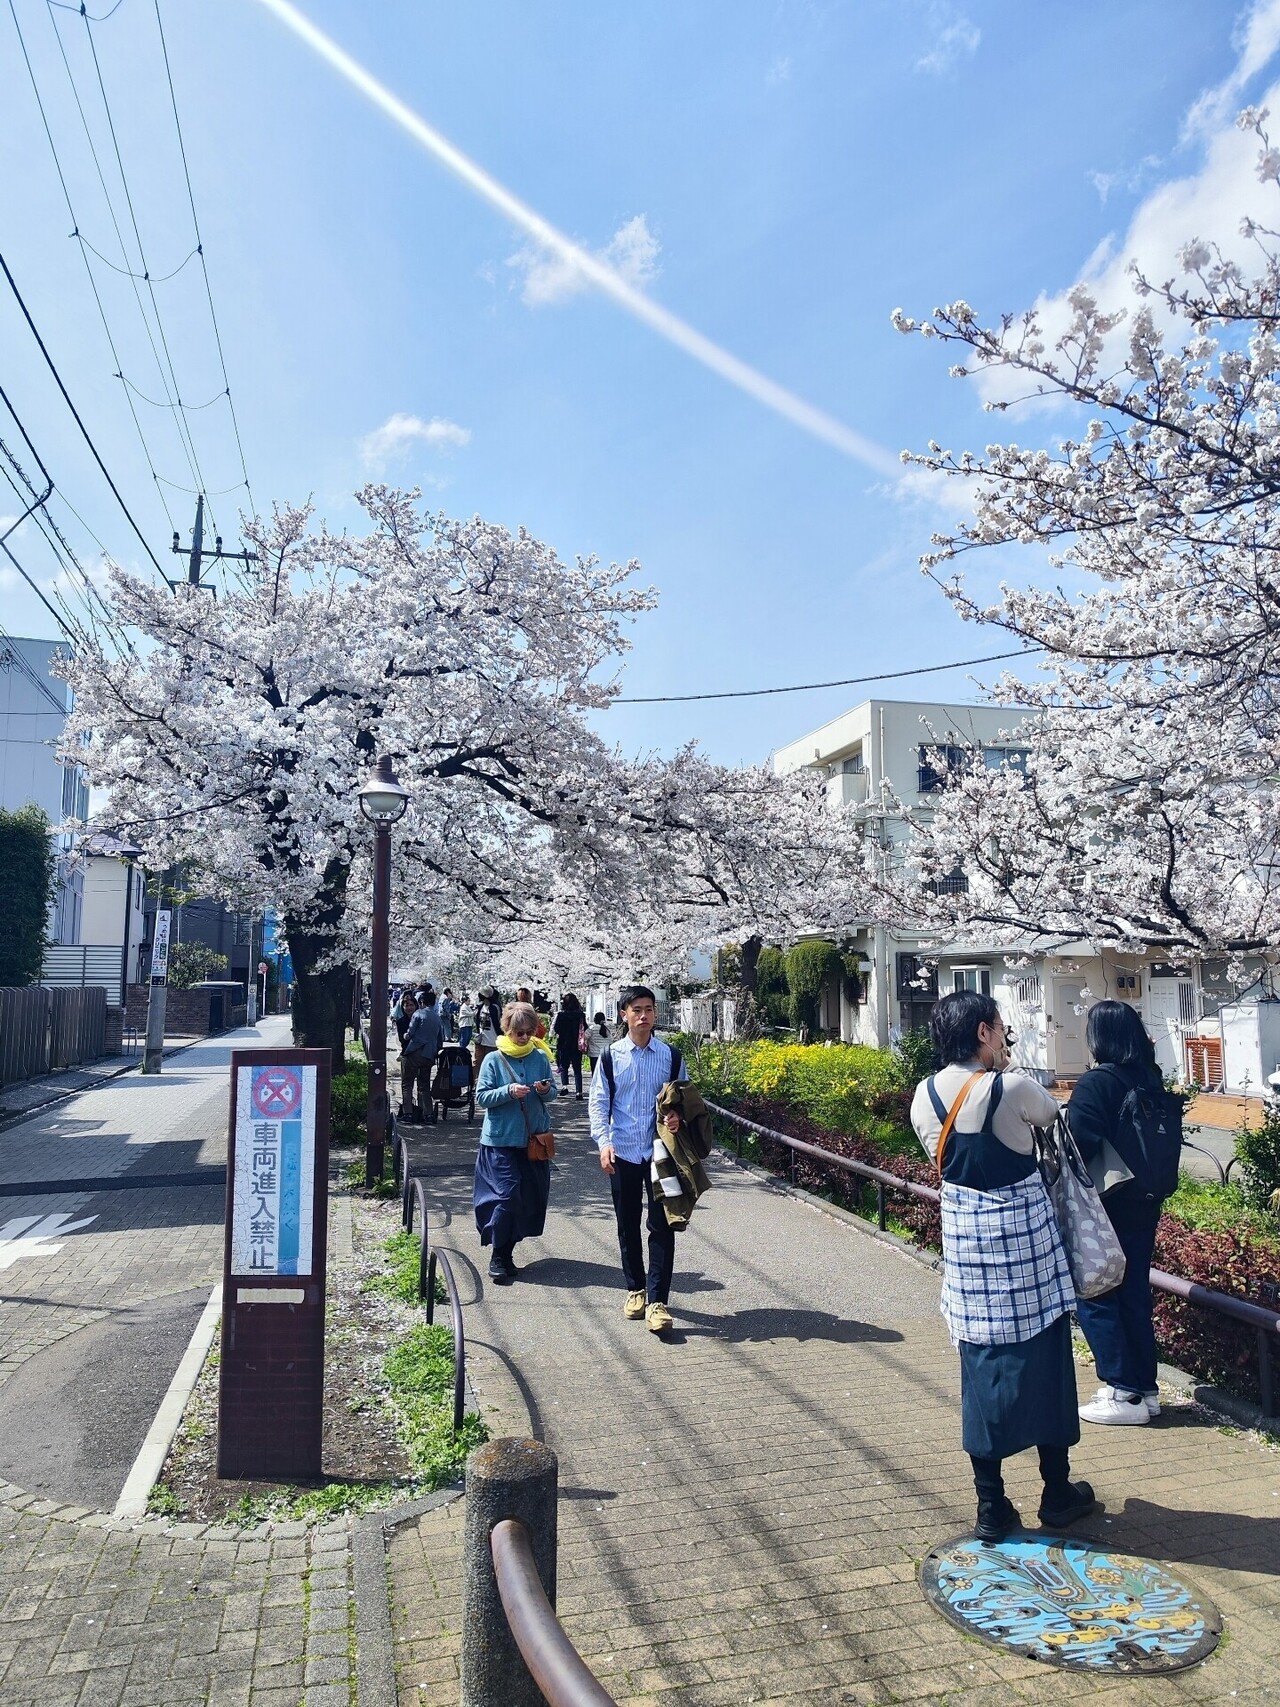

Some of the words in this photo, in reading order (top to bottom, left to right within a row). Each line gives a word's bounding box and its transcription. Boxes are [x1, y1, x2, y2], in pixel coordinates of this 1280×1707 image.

[249, 1122, 278, 1270] 車両進入禁止
